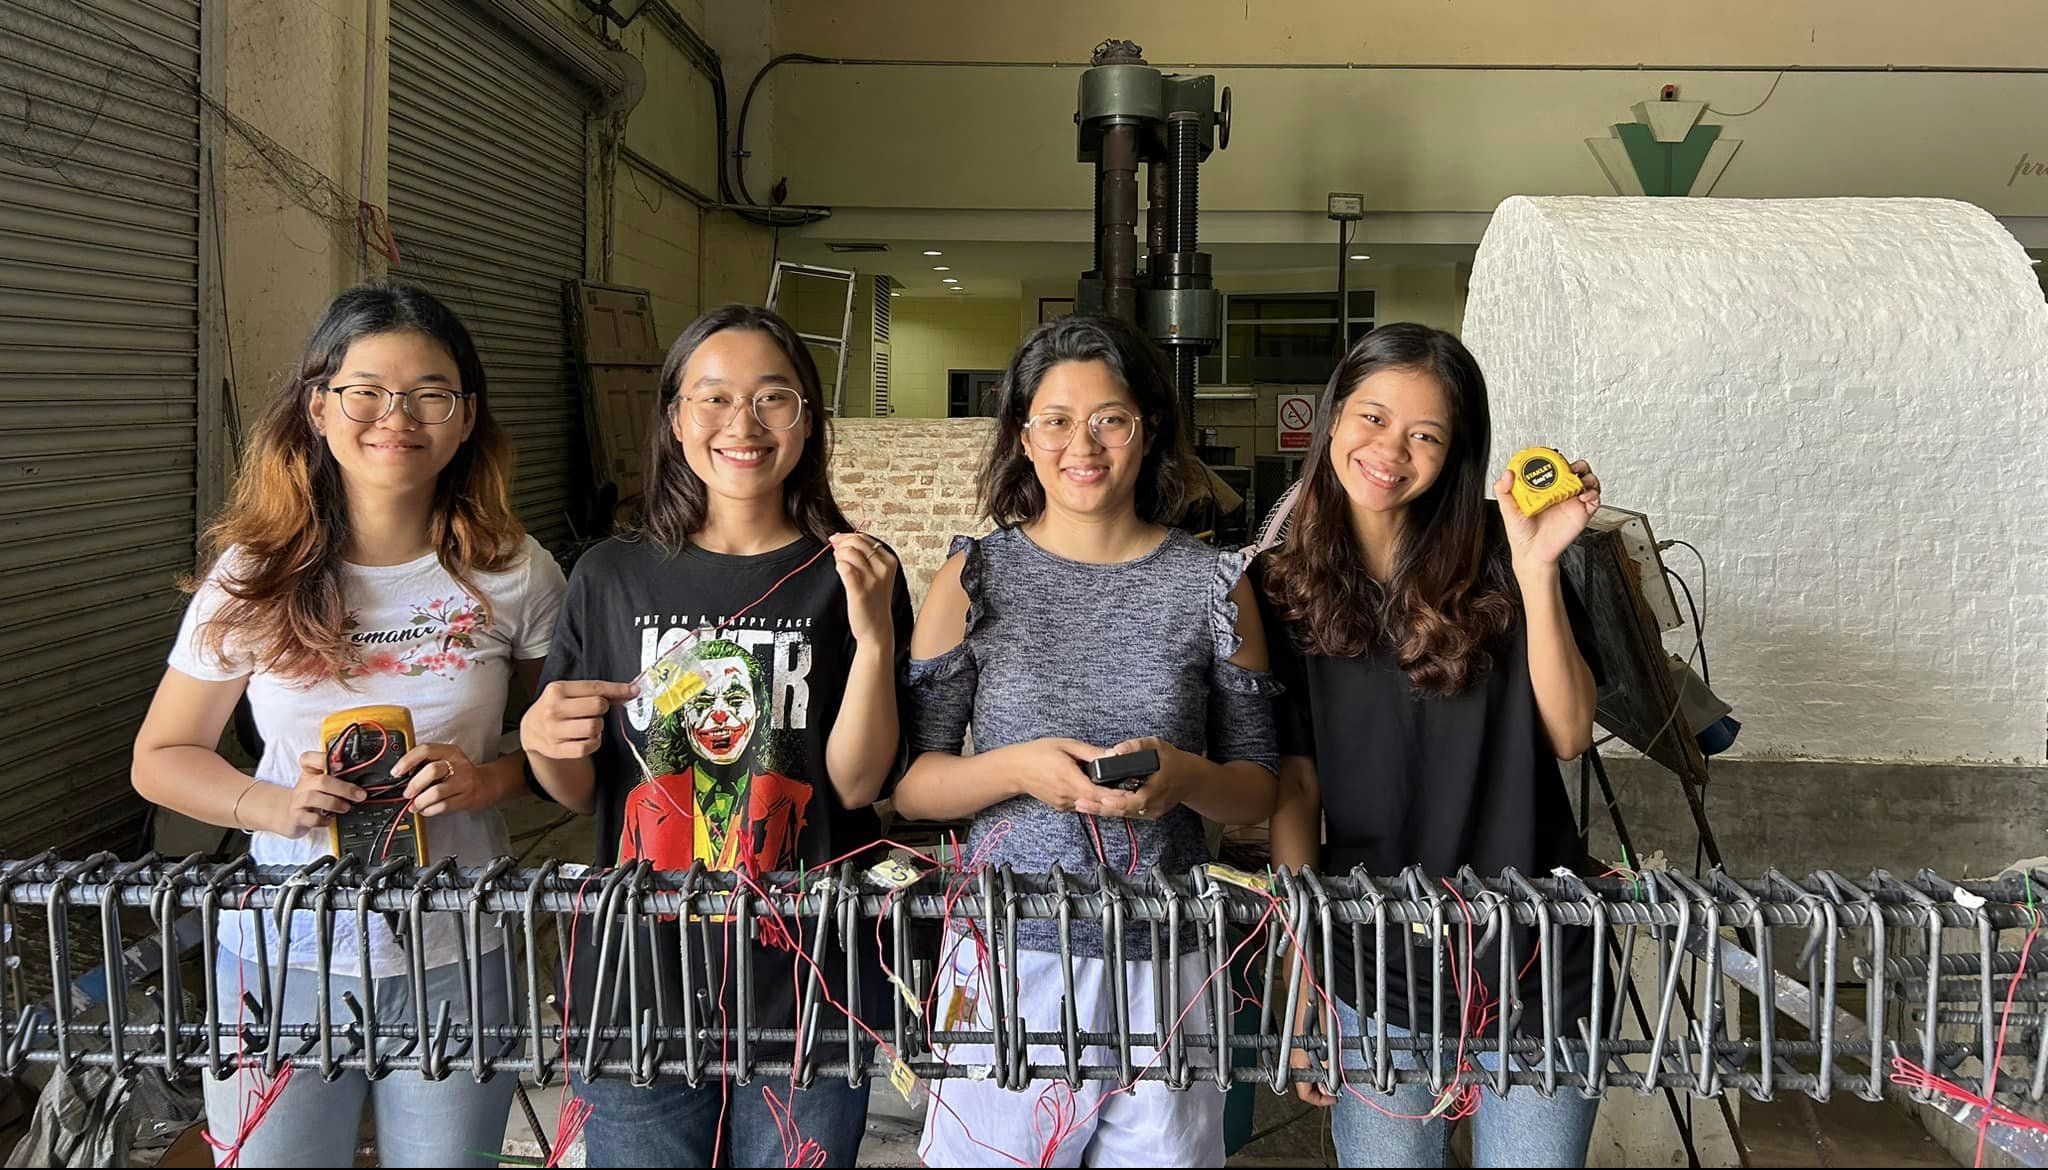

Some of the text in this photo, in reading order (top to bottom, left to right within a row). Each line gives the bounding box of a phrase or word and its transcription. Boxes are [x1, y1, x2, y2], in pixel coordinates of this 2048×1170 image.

[2007, 153, 2048, 187] pr
[1525, 463, 1552, 480] STANLEY
[634, 614, 812, 629] PUT ON A HAPPY FACE
[345, 625, 437, 645] omance
